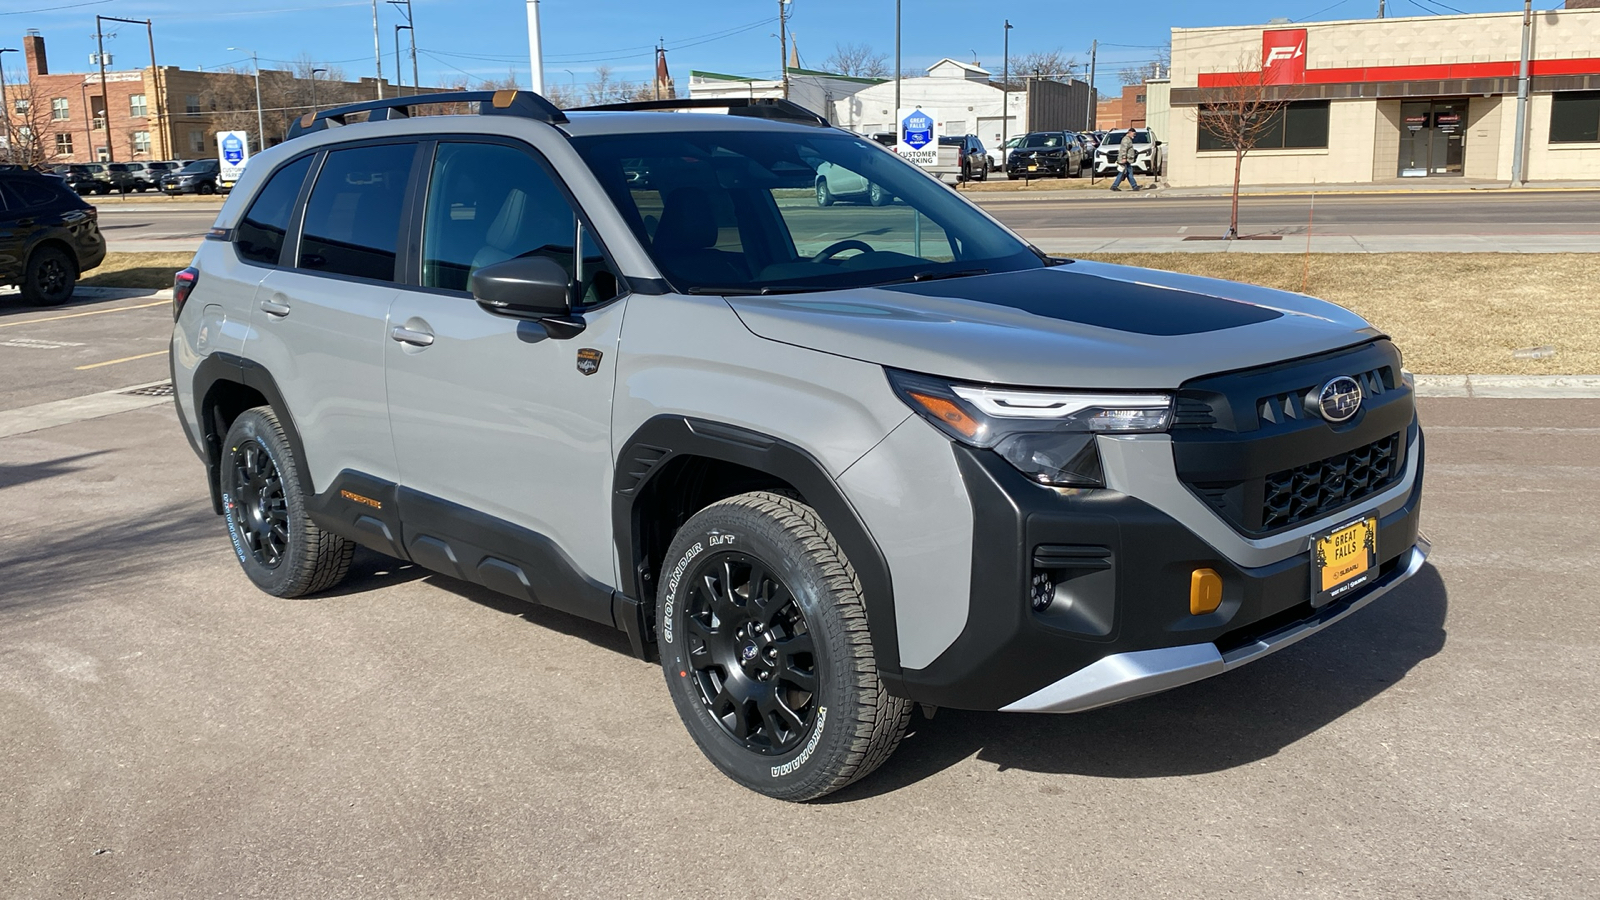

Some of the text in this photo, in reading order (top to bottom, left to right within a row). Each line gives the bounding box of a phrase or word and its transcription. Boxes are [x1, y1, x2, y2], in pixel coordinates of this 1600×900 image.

[1335, 529, 1357, 547] GREAT
[1335, 541, 1357, 560] FALLS
[1340, 563, 1359, 577] SUBARU
[663, 535, 735, 644] GEOLANDAR A/T
[771, 706, 827, 777] YOKOHAMA
